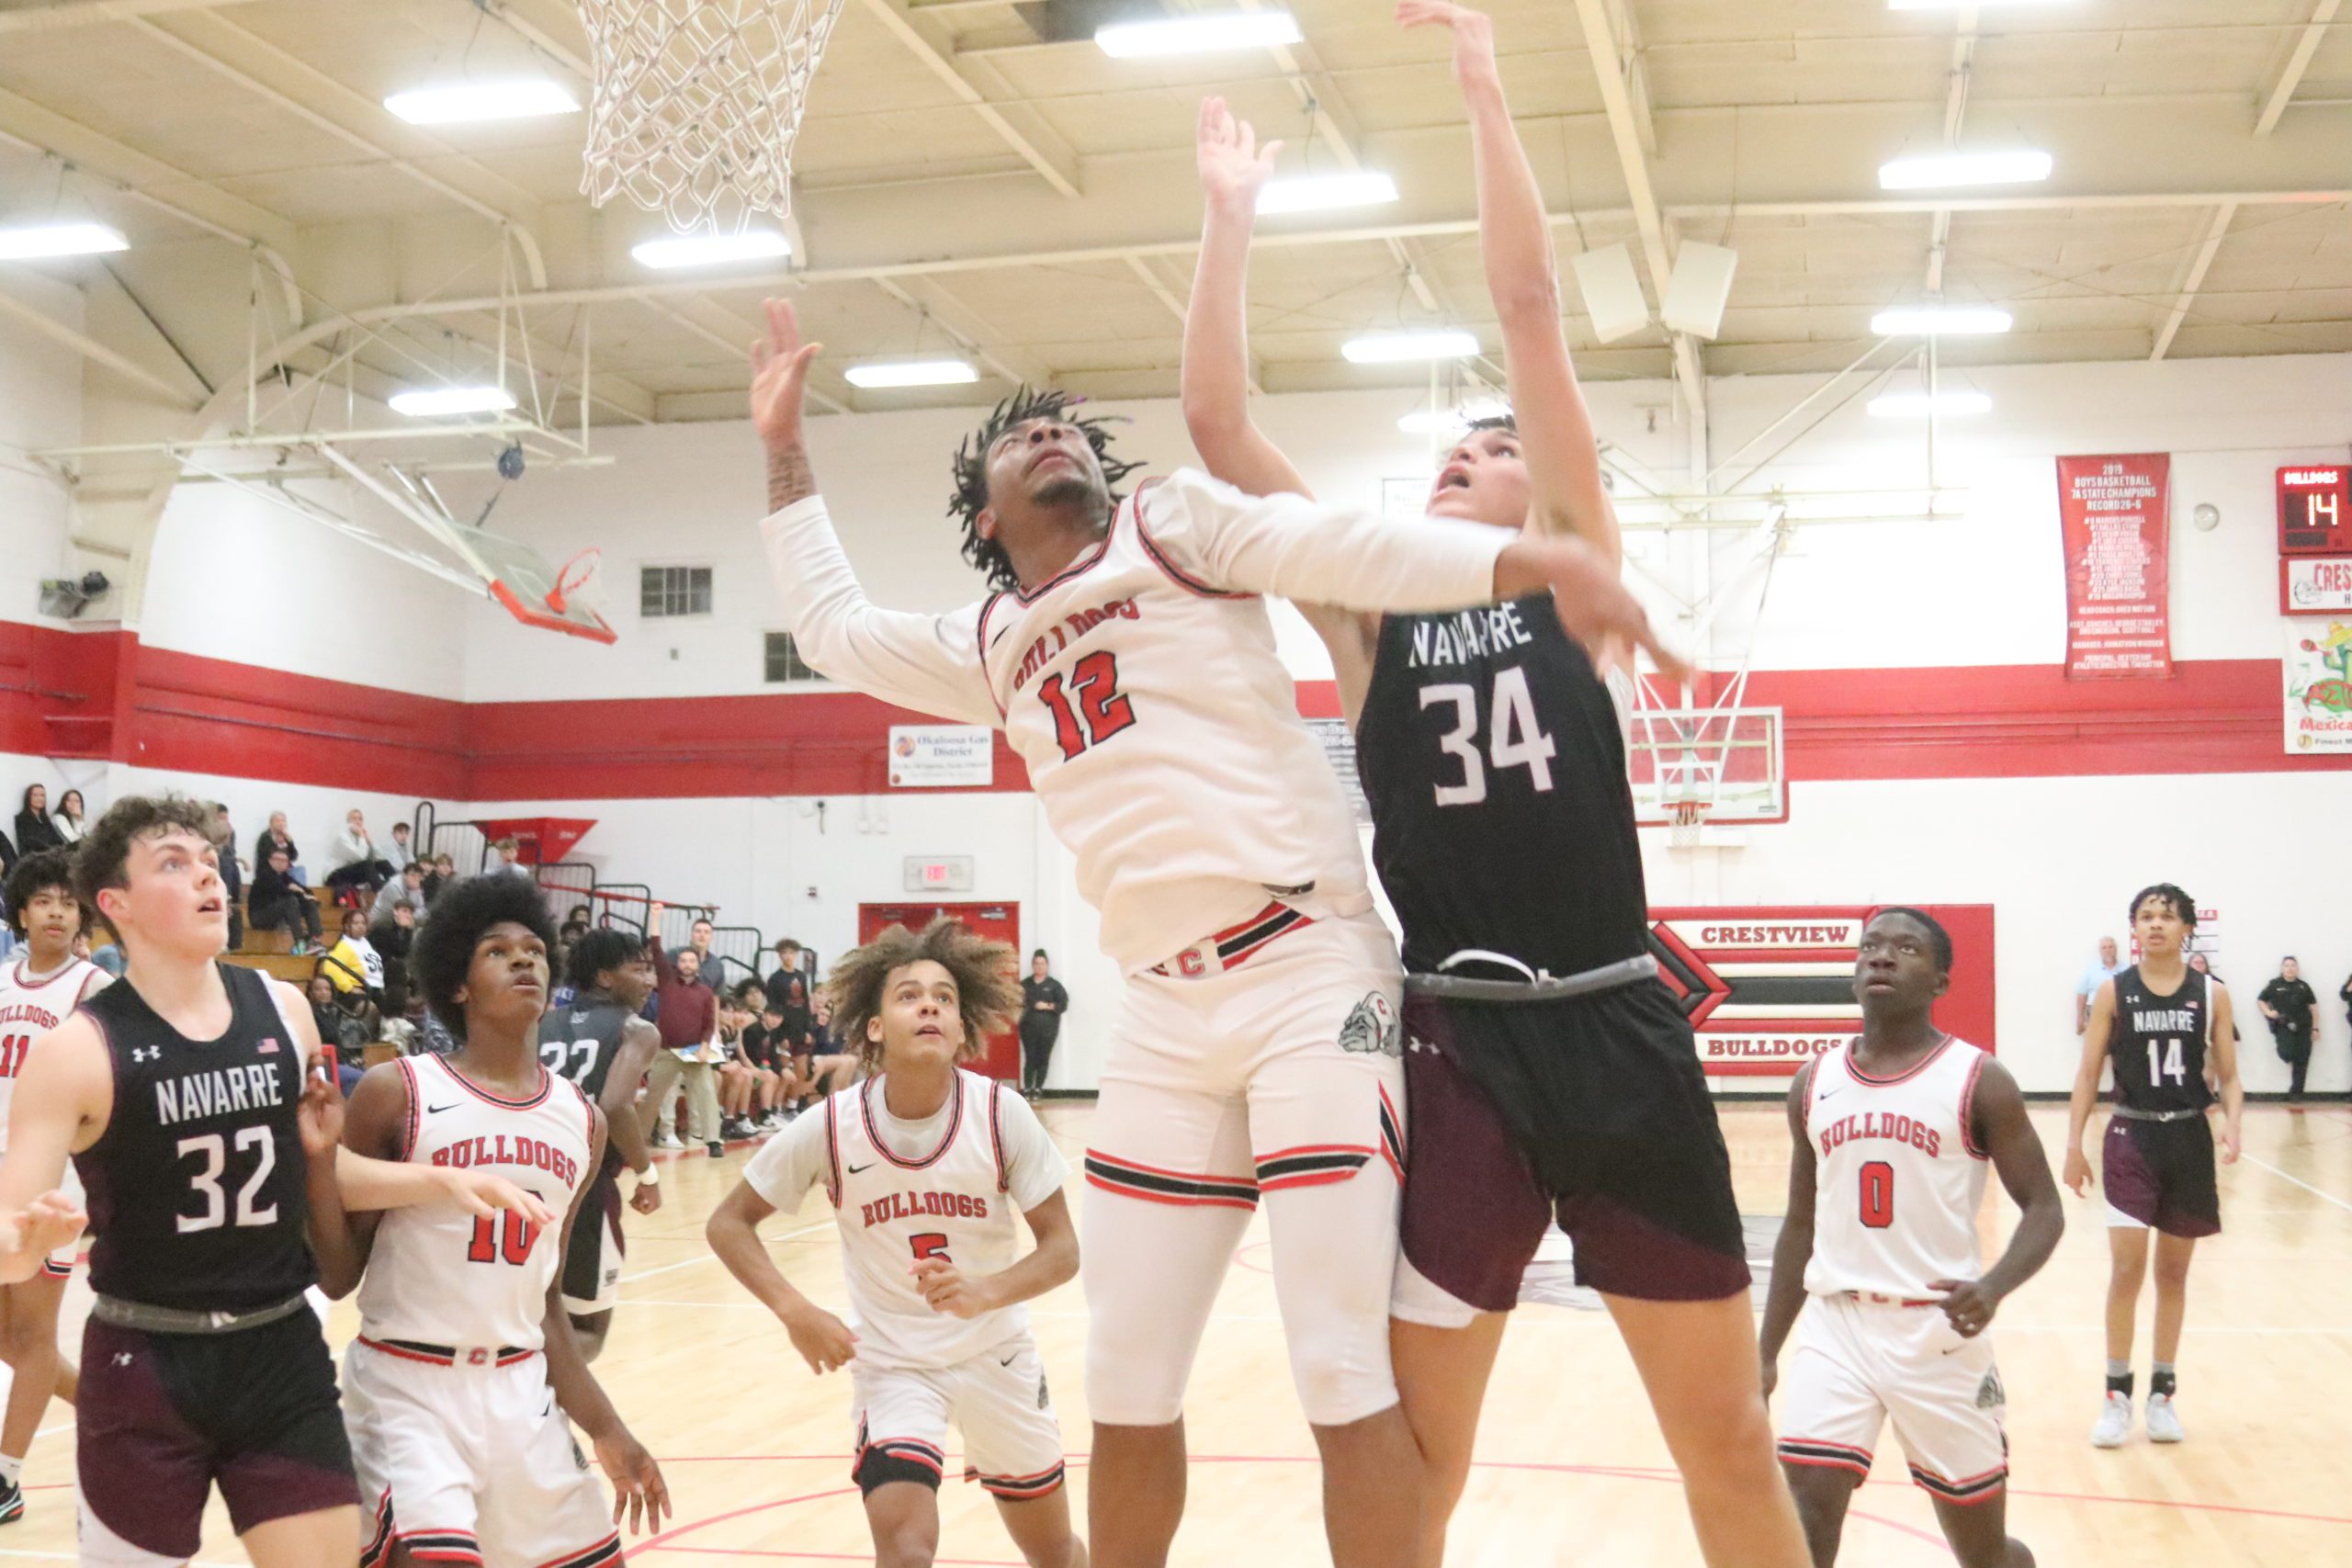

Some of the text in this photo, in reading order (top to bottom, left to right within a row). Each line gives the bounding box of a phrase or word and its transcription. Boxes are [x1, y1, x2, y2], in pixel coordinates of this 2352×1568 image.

[2075, 475, 2151, 488] BOYS BASKETBALL
[2102, 464, 2123, 475] 2019
[2082, 488, 2107, 499] STATE
[2107, 487, 2156, 499] CHAMPIONS
[2086, 500, 2120, 511] RECORD
[2308, 493, 2338, 525] 14
[1038, 649, 1137, 762] 12
[1419, 665, 1556, 807] 34
[1701, 926, 1849, 943] CRESTVIEW
[2133, 1010, 2195, 1033] NAVARRE
[2146, 1038, 2186, 1088] 14
[155, 1063, 283, 1126] NAVARRE
[1819, 1112, 1941, 1158] BULLDOGS
[175, 1125, 278, 1233] 32
[432, 1134, 578, 1191] BULLDOGS
[861, 1190, 988, 1228] BULLDOGS
[1859, 1161, 1894, 1228] 0
